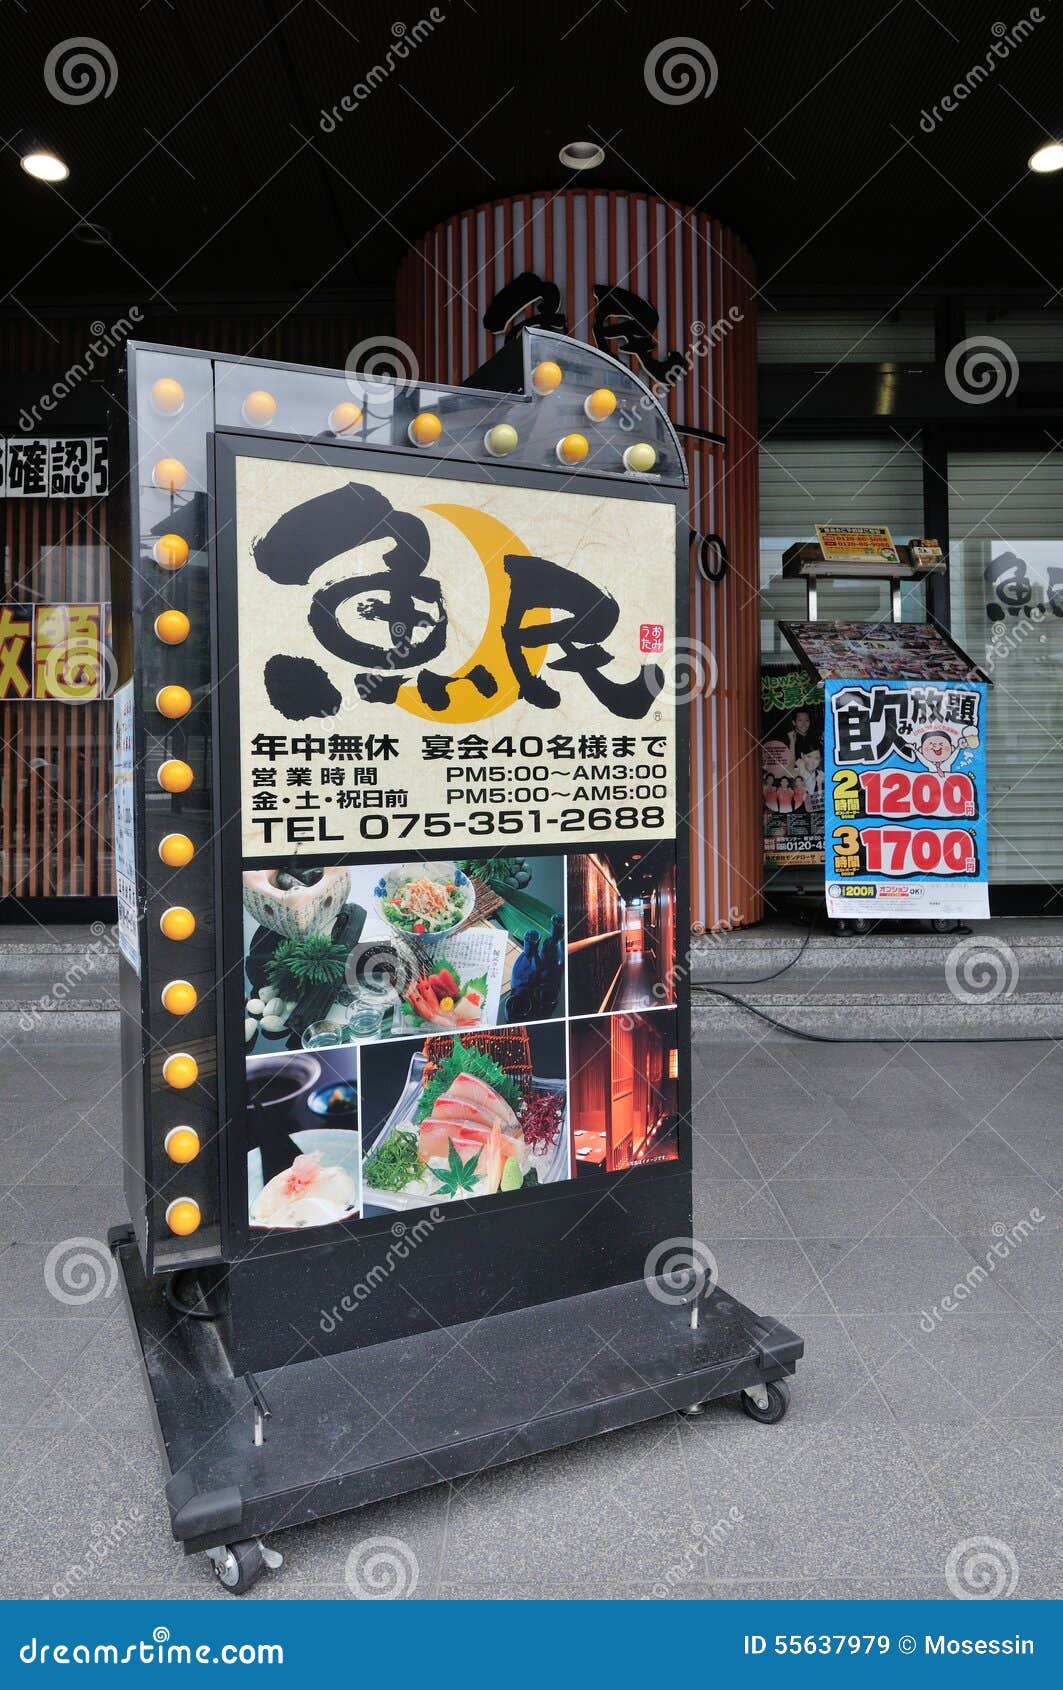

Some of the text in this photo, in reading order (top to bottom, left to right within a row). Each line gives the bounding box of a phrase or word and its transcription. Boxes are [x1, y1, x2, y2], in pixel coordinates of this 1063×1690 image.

[0, 440, 108, 495] 確認
[253, 482, 665, 721] 魚民
[251, 733, 667, 761] 年中無休 宴会40名様まで
[251, 767, 378, 787] 営業時間
[252, 789, 409, 811] 金・土・祝日前
[251, 806, 665, 844] TEL 075-351-2688
